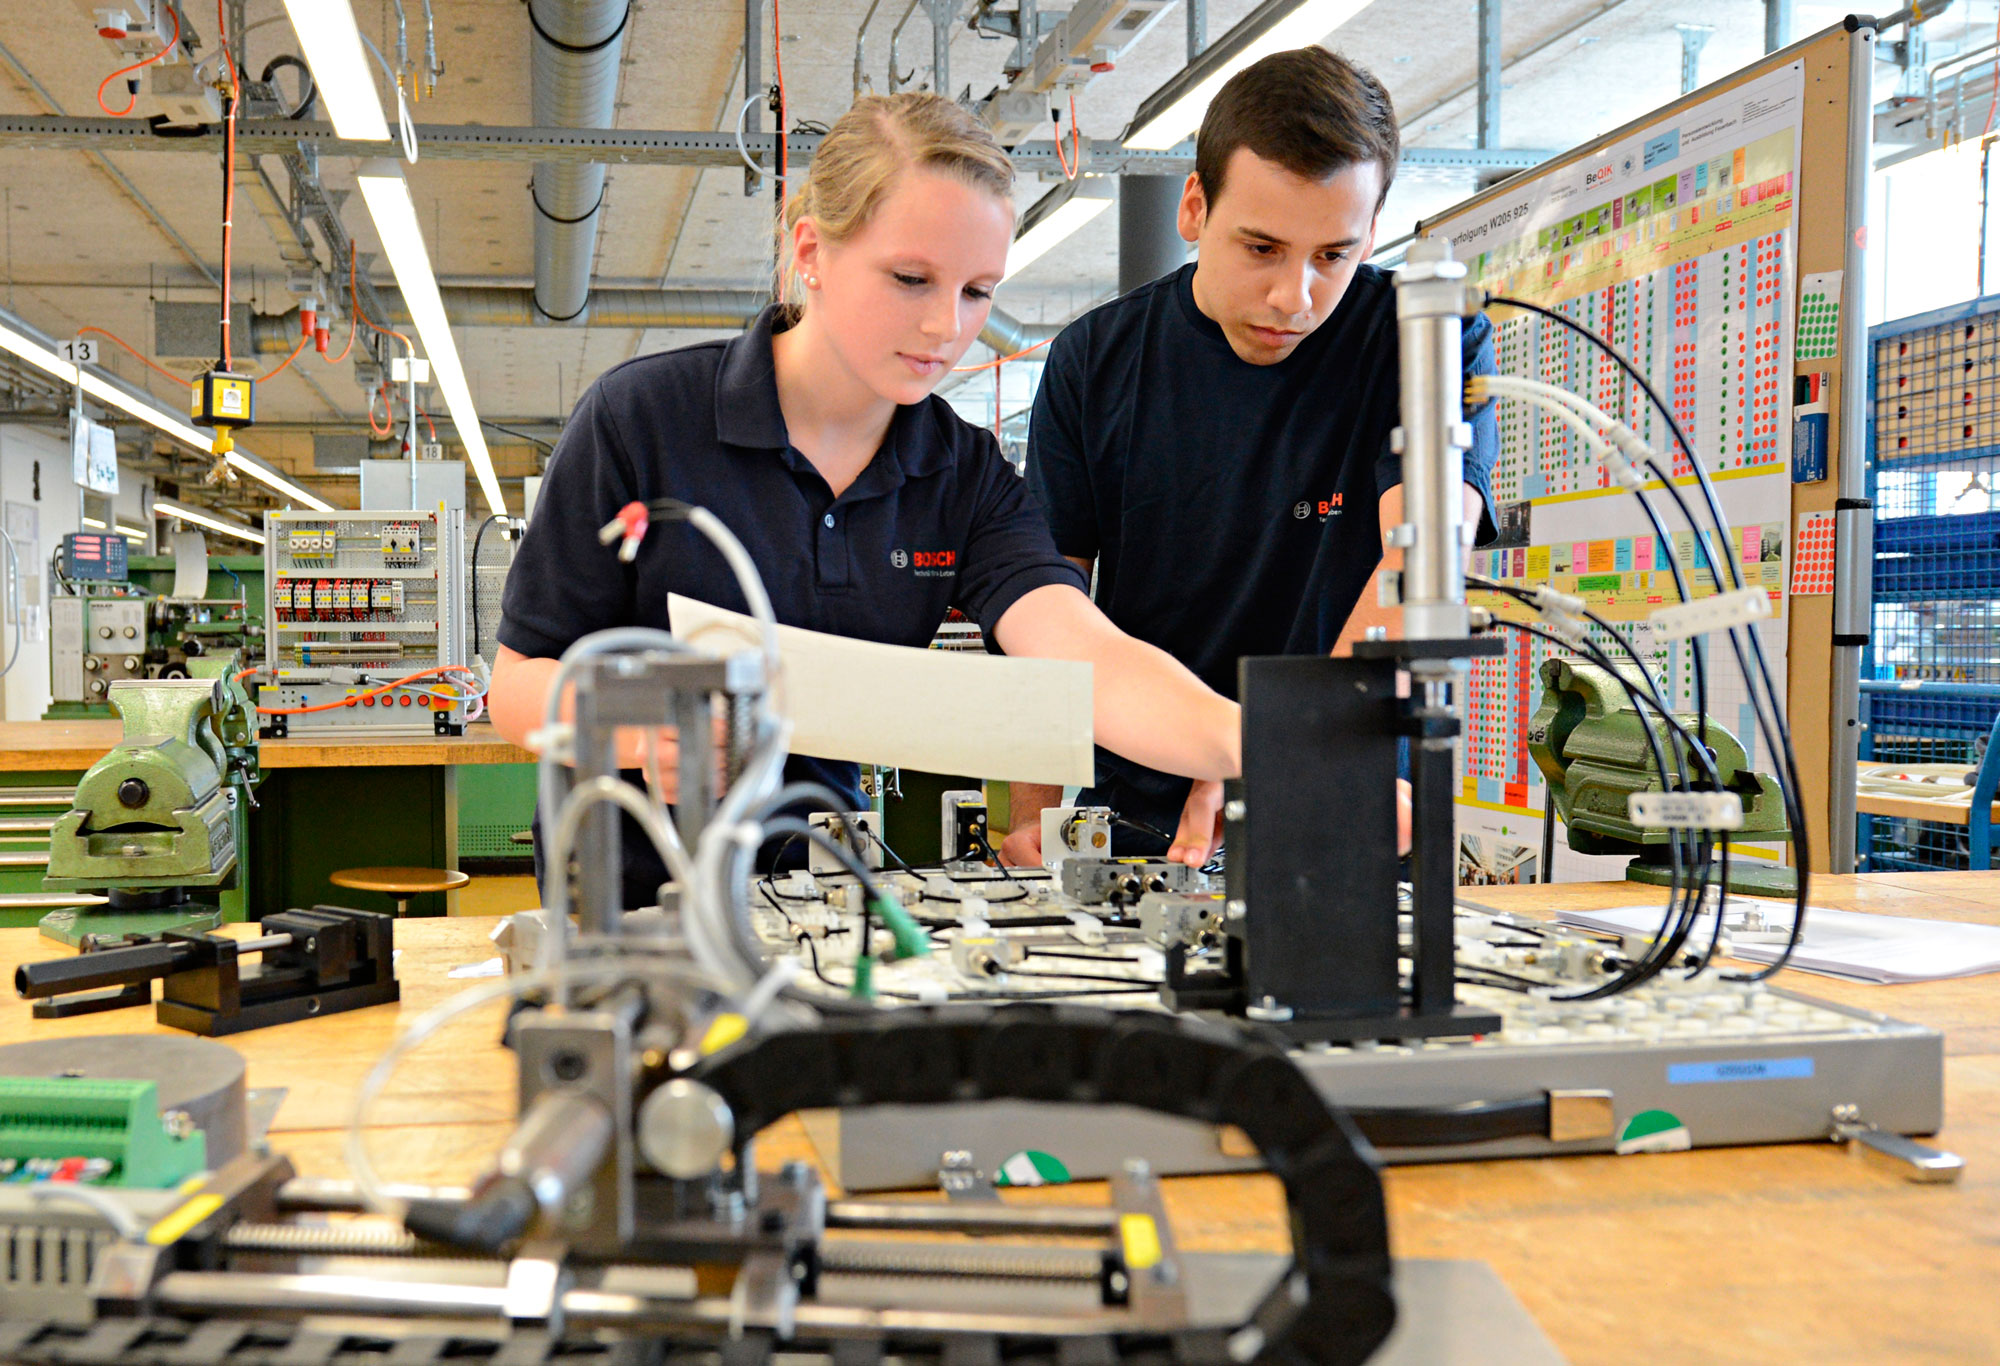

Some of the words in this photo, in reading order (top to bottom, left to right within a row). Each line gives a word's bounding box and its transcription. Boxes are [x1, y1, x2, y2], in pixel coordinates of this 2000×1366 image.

[1586, 164, 1613, 185] BeQIK
[1489, 209, 1512, 230] W205
[1513, 202, 1529, 219] 925
[64, 342, 91, 361] 13
[425, 446, 438, 458] 18
[913, 550, 956, 567] BOSCH
